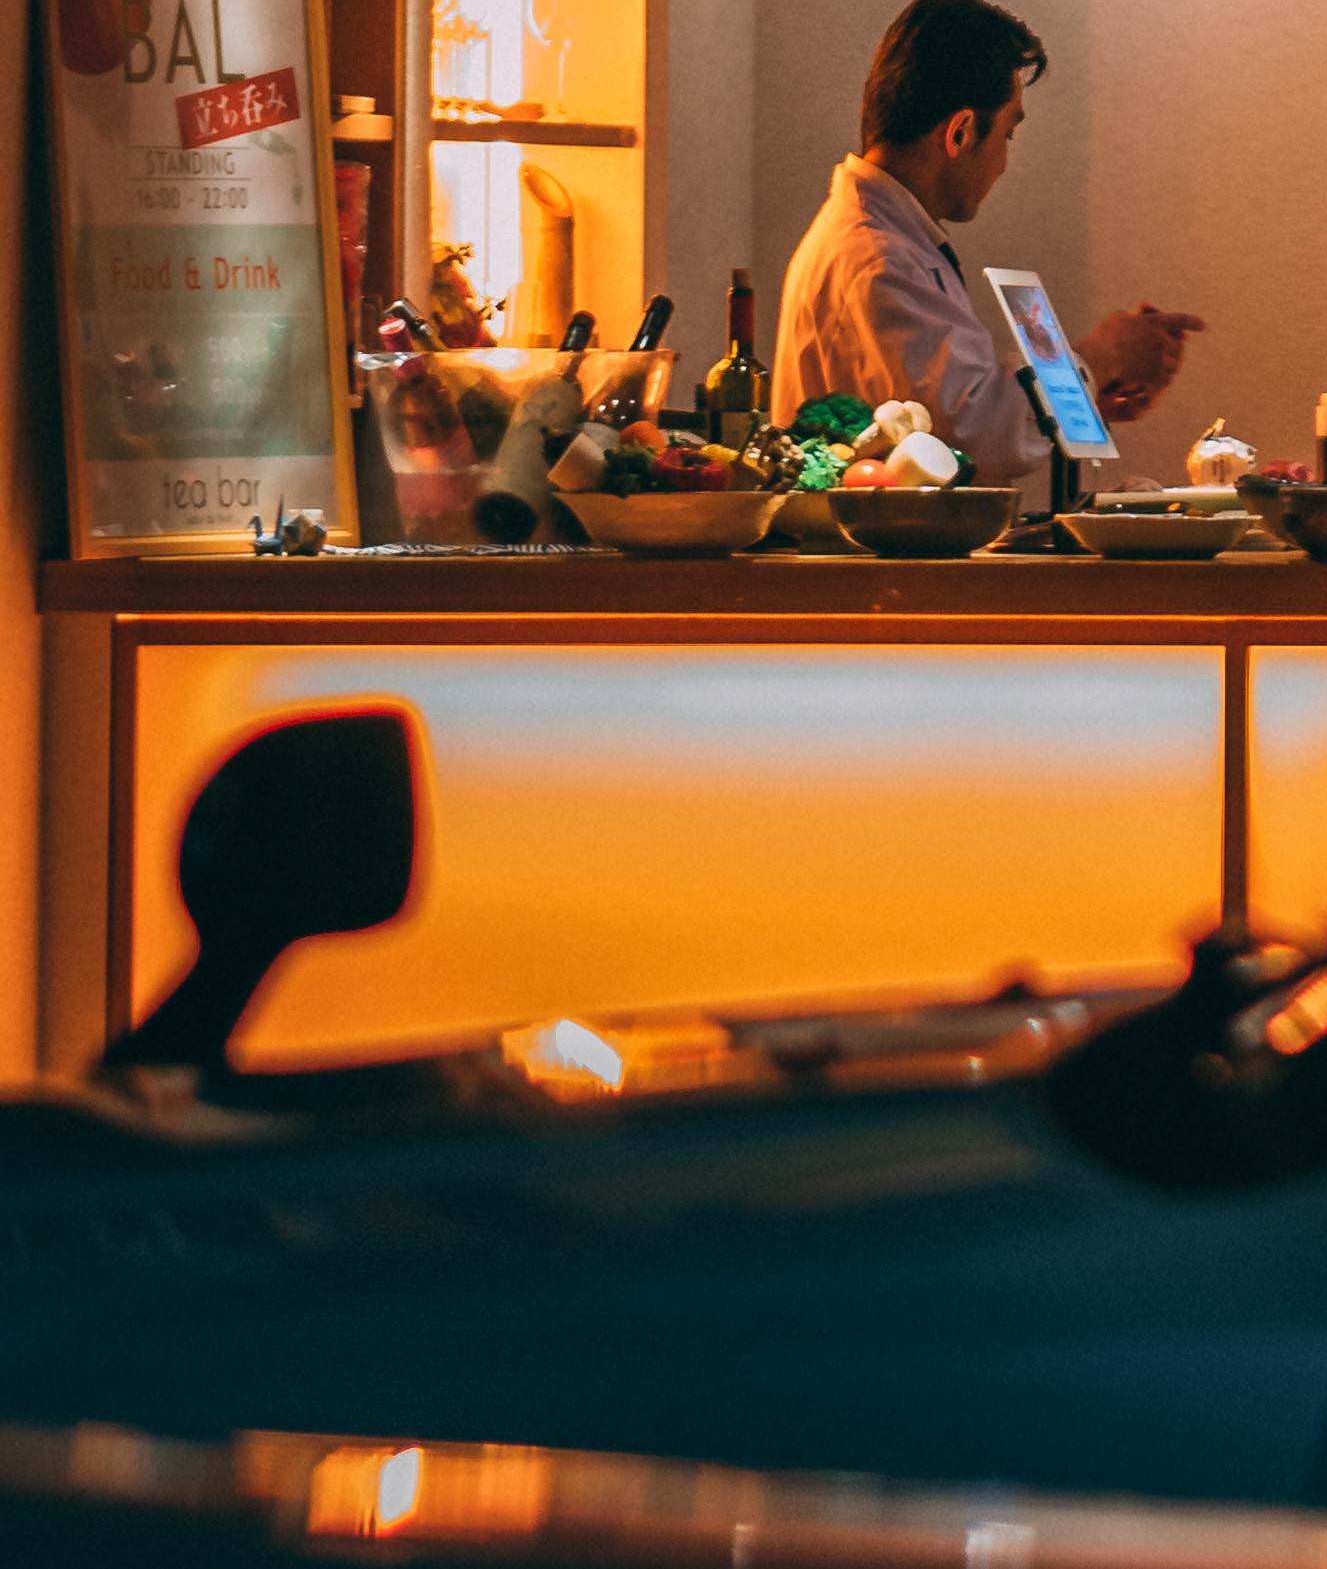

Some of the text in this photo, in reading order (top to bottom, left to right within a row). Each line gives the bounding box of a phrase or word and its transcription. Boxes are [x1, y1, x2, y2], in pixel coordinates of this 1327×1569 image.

[146, 150, 236, 176] STANDING
[203, 185, 248, 210] 22:00
[111, 256, 281, 290] Food & Drink
[163, 465, 261, 509] tea bar
